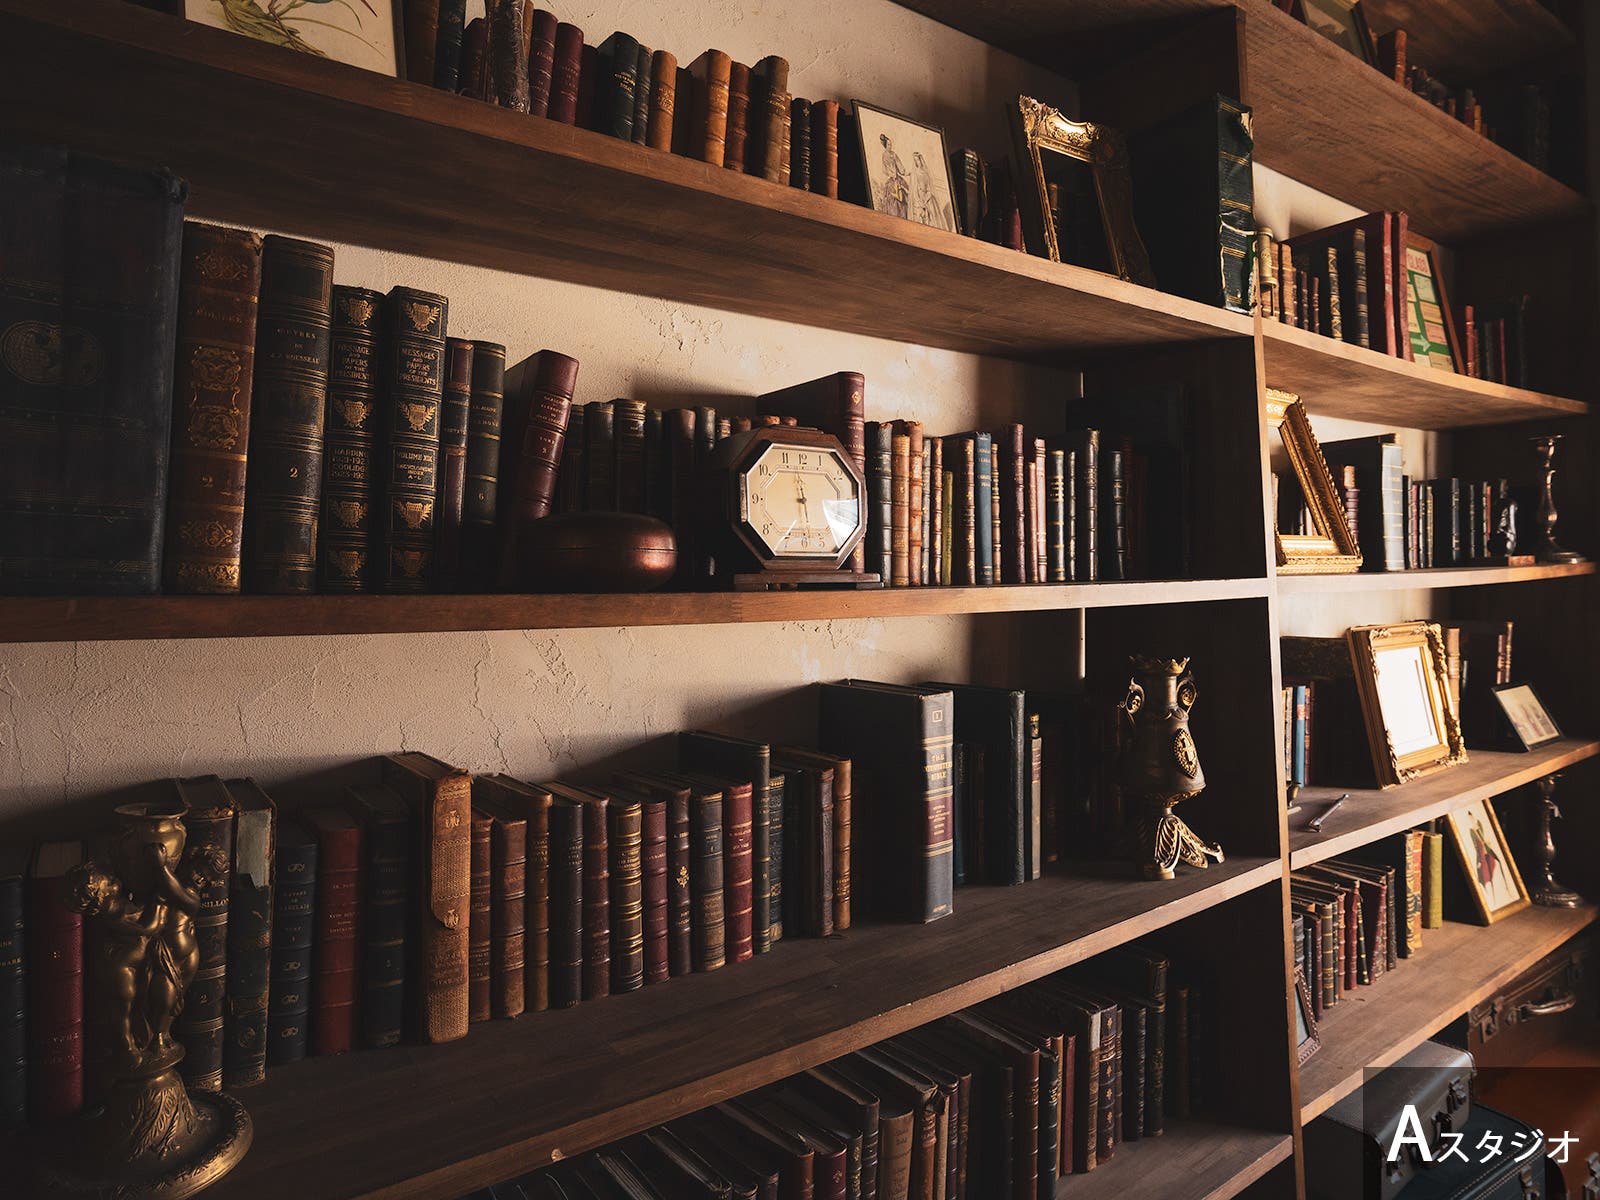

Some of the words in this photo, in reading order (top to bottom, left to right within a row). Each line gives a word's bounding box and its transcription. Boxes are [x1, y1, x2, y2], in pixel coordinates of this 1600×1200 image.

[401, 347, 436, 360] MESSAGES
[406, 361, 431, 372] PAPERS
[396, 450, 423, 461] VOLUME
[782, 453, 789, 464] 11
[798, 453, 807, 465] 12
[818, 455, 822, 466] 1
[289, 467, 299, 478] 2
[759, 464, 769, 476] 10
[836, 470, 843, 480] 2
[200, 476, 213, 488] 2
[752, 494, 759, 504] 9
[762, 524, 770, 535] 8
[801, 538, 808, 548] 6
[819, 538, 825, 548] 5
[200, 993, 208, 1004] 2
